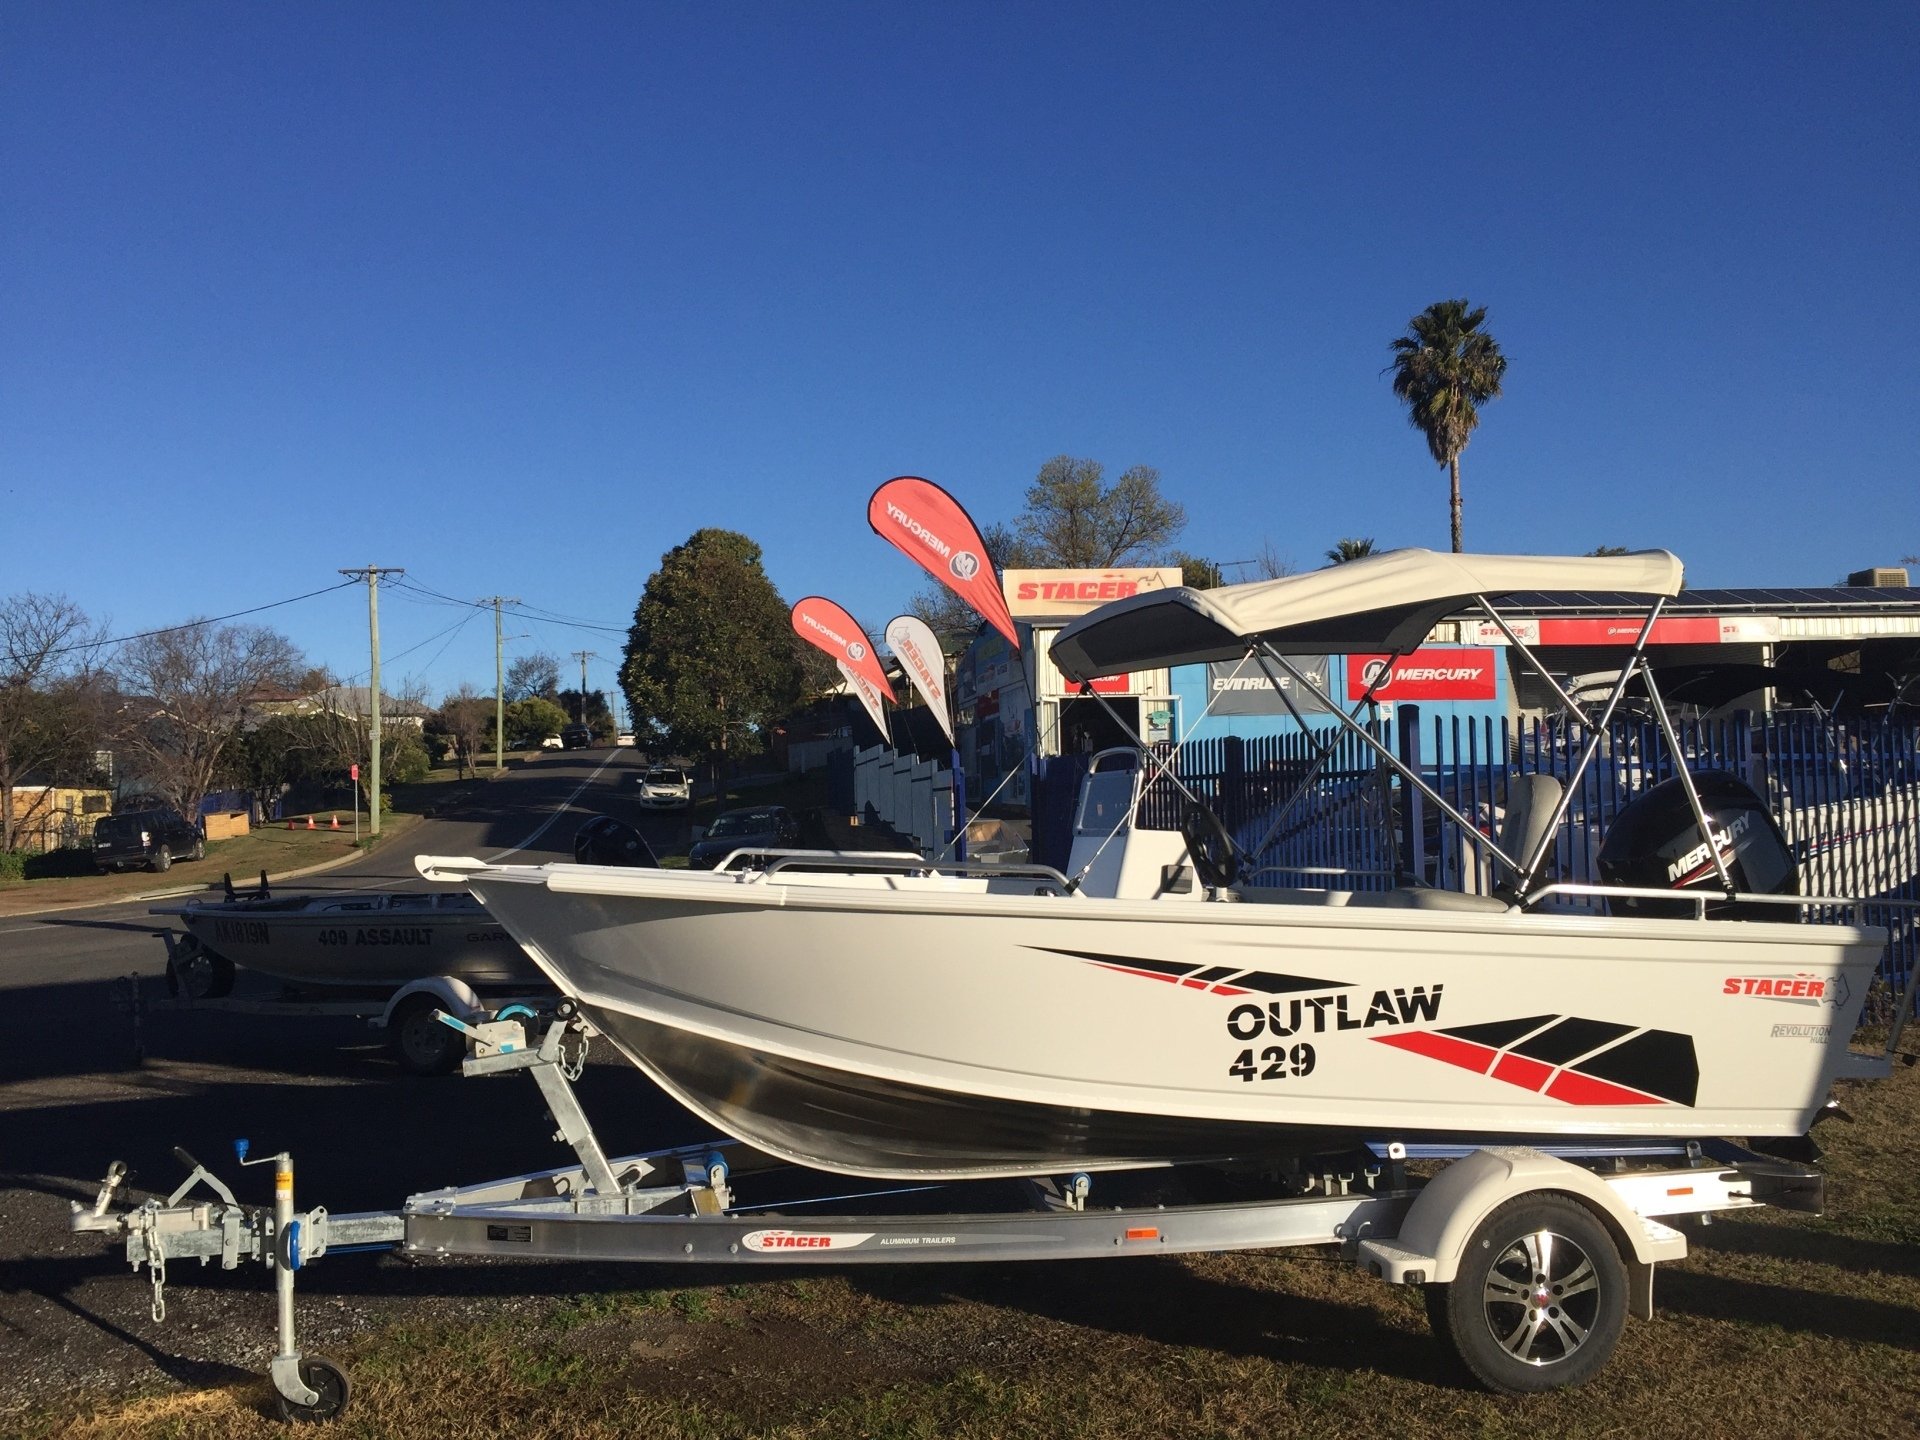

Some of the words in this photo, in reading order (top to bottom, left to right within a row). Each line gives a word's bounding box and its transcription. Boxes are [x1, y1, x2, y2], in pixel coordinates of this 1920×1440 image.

[1017, 581, 1138, 600] STACER
[1395, 668, 1483, 682] MERCURY
[1667, 810, 1750, 882] MERCURY
[318, 928, 348, 945] 409
[355, 928, 434, 946] ASSAULT
[1722, 978, 1825, 997] STACER
[1227, 984, 1444, 1041] OUTLAW
[1770, 1025, 1832, 1037] REVOLUTION
[1228, 1042, 1316, 1082] 429
[762, 1236, 832, 1248] STACER
[921, 1236, 956, 1244] TRAILERS
